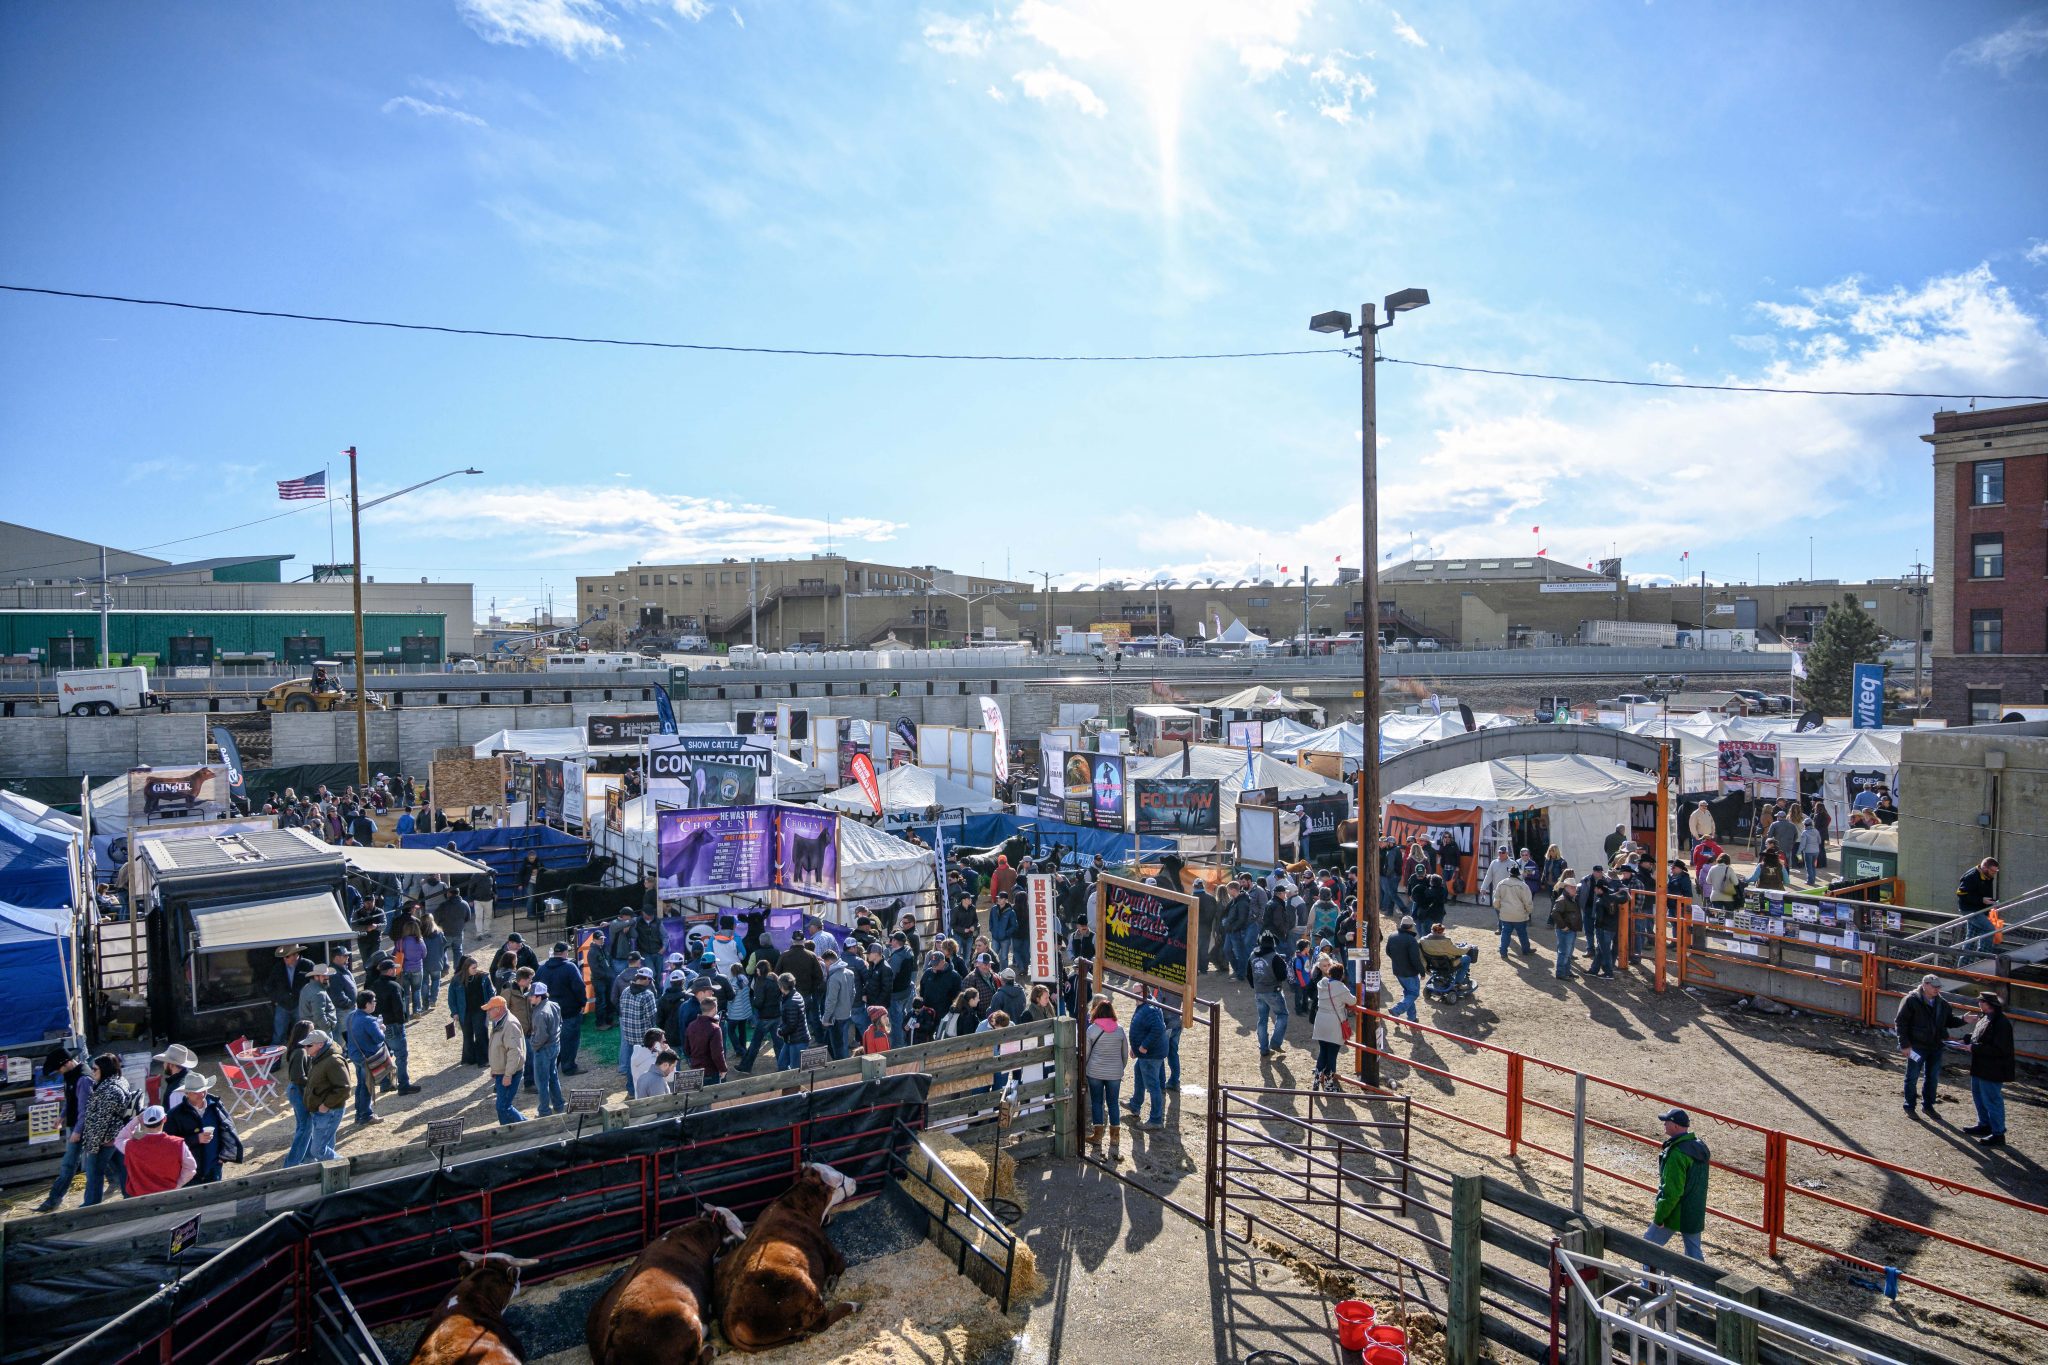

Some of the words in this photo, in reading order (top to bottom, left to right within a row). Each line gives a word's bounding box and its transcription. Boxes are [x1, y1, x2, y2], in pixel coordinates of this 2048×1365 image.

[1858, 676, 1881, 729] viteq
[688, 741, 709, 749] SHOW
[711, 741, 739, 749] CATTLE
[655, 754, 767, 773] CONION
[1140, 791, 1213, 808] FOLLOW
[720, 812, 729, 820] HE
[730, 811, 745, 819] WAS
[746, 810, 758, 818] THE
[1860, 863, 1880, 871] United
[1034, 879, 1049, 977] HEREFORD
